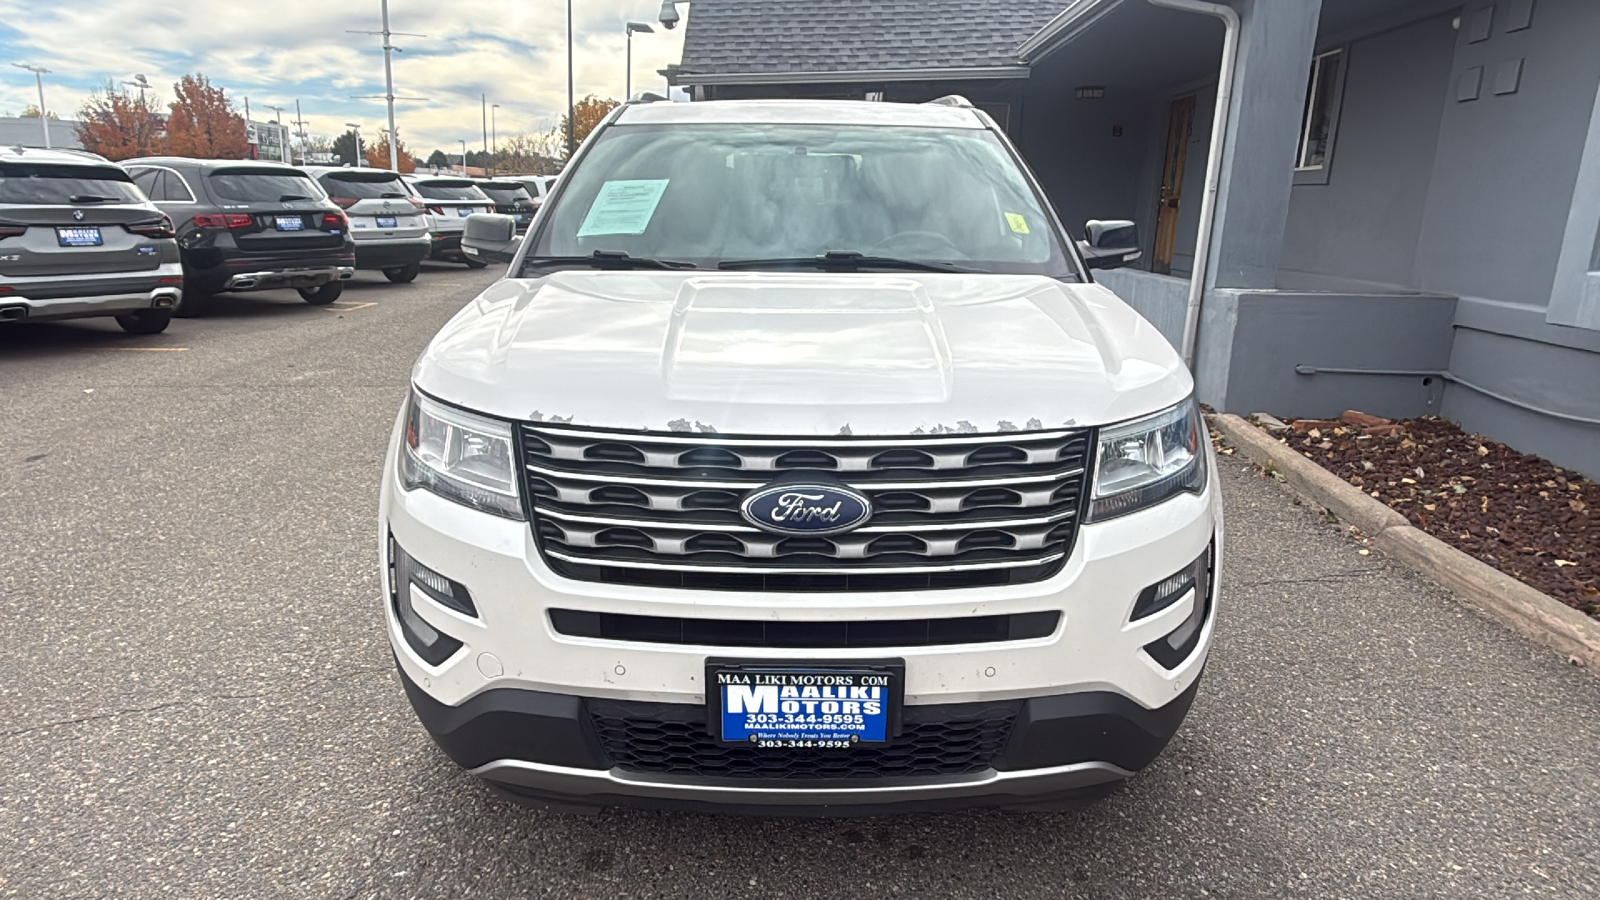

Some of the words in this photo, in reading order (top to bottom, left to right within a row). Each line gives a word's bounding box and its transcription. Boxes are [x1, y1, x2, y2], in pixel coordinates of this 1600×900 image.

[771, 492, 842, 522] Ford
[718, 674, 750, 684] MAA
[790, 675, 853, 685] MOTORS
[861, 676, 888, 686] COM
[746, 713, 864, 724] 303-344-9595
[744, 723, 866, 731] MAALIKIMOTORS.COM
[777, 732, 799, 740] Nobody
[757, 740, 850, 748] 303-344-9595
